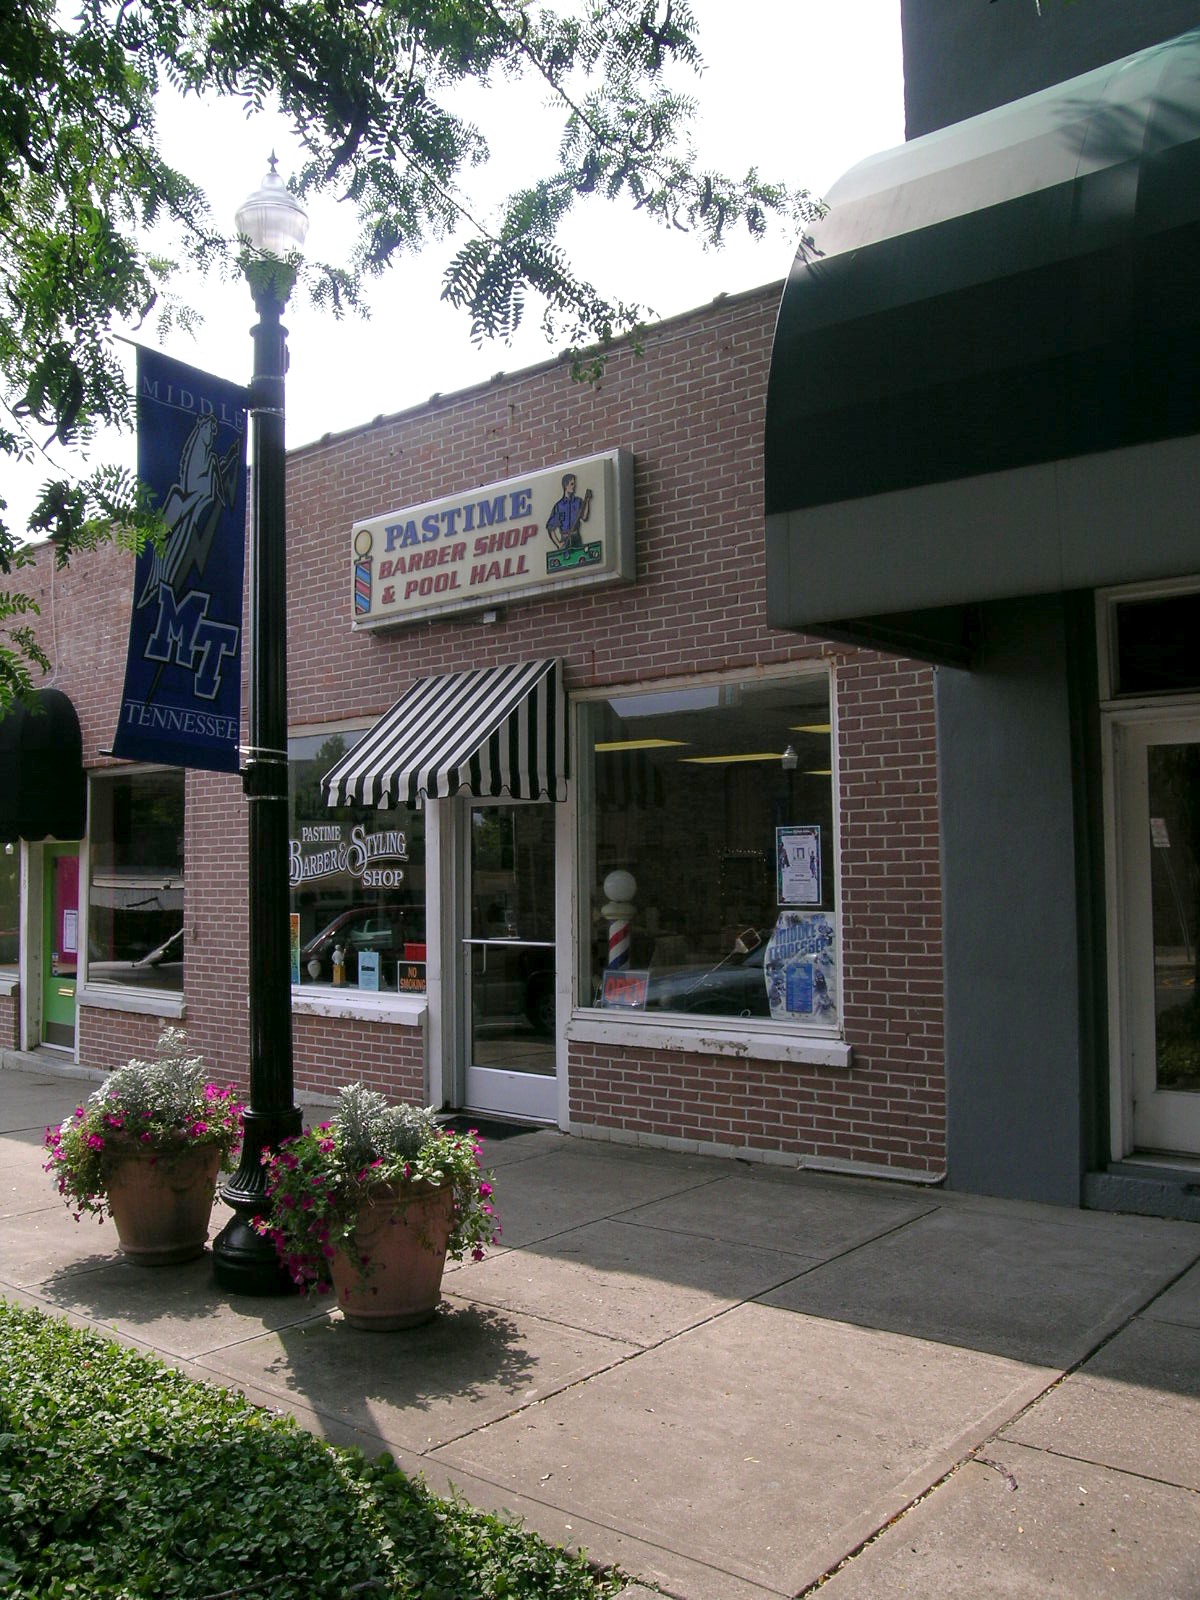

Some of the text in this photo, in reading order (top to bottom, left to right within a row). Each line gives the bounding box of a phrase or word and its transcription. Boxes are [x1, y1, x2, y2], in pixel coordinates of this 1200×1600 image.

[142, 377, 242, 431] MIDDLE
[385, 489, 533, 552] PASTIME
[379, 525, 538, 580] BARBER SHOP
[382, 555, 530, 604] & POOL HALL
[125, 704, 238, 740] TENNESSEE
[302, 827, 341, 842] PASTIME
[363, 871, 403, 887] SHOP
[400, 978, 426, 990] SMOKING
[408, 967, 418, 978] NO
[604, 975, 646, 1002] OPEN
